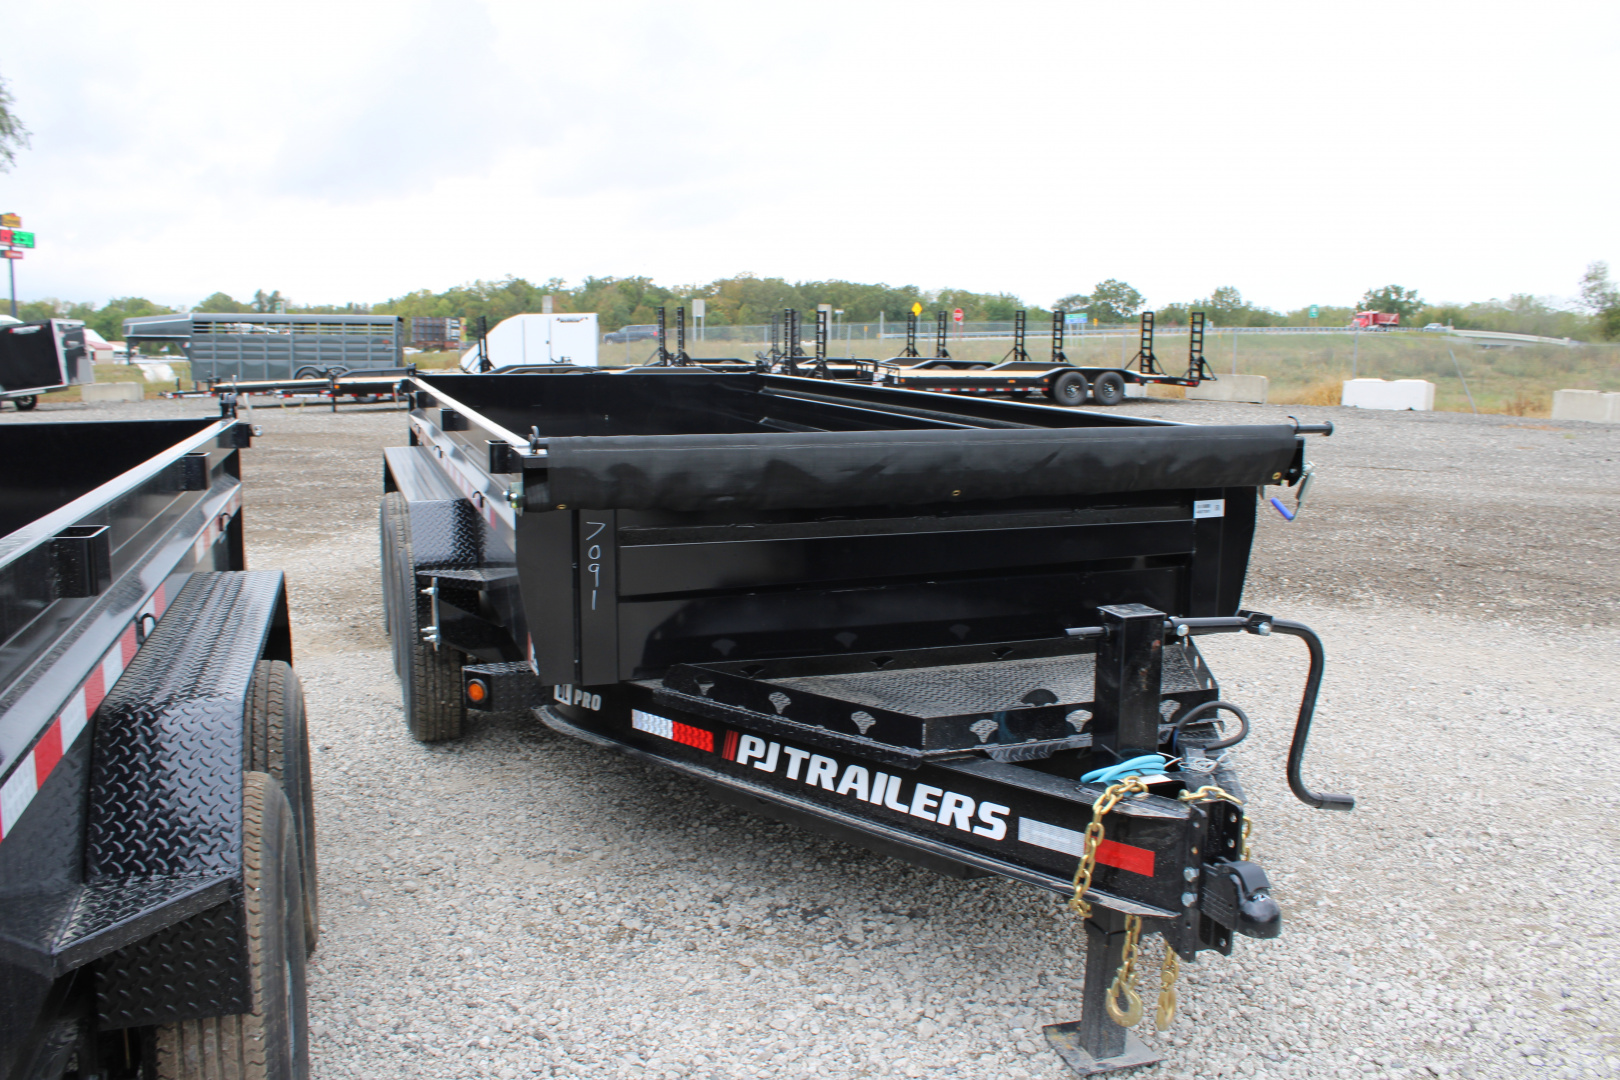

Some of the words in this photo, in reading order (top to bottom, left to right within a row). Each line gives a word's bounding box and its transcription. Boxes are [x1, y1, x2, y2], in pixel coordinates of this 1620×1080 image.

[586, 521, 606, 611] 7091
[573, 688, 602, 712] PRO
[736, 734, 780, 773] PJ
[783, 745, 1011, 841] TRAILERS
